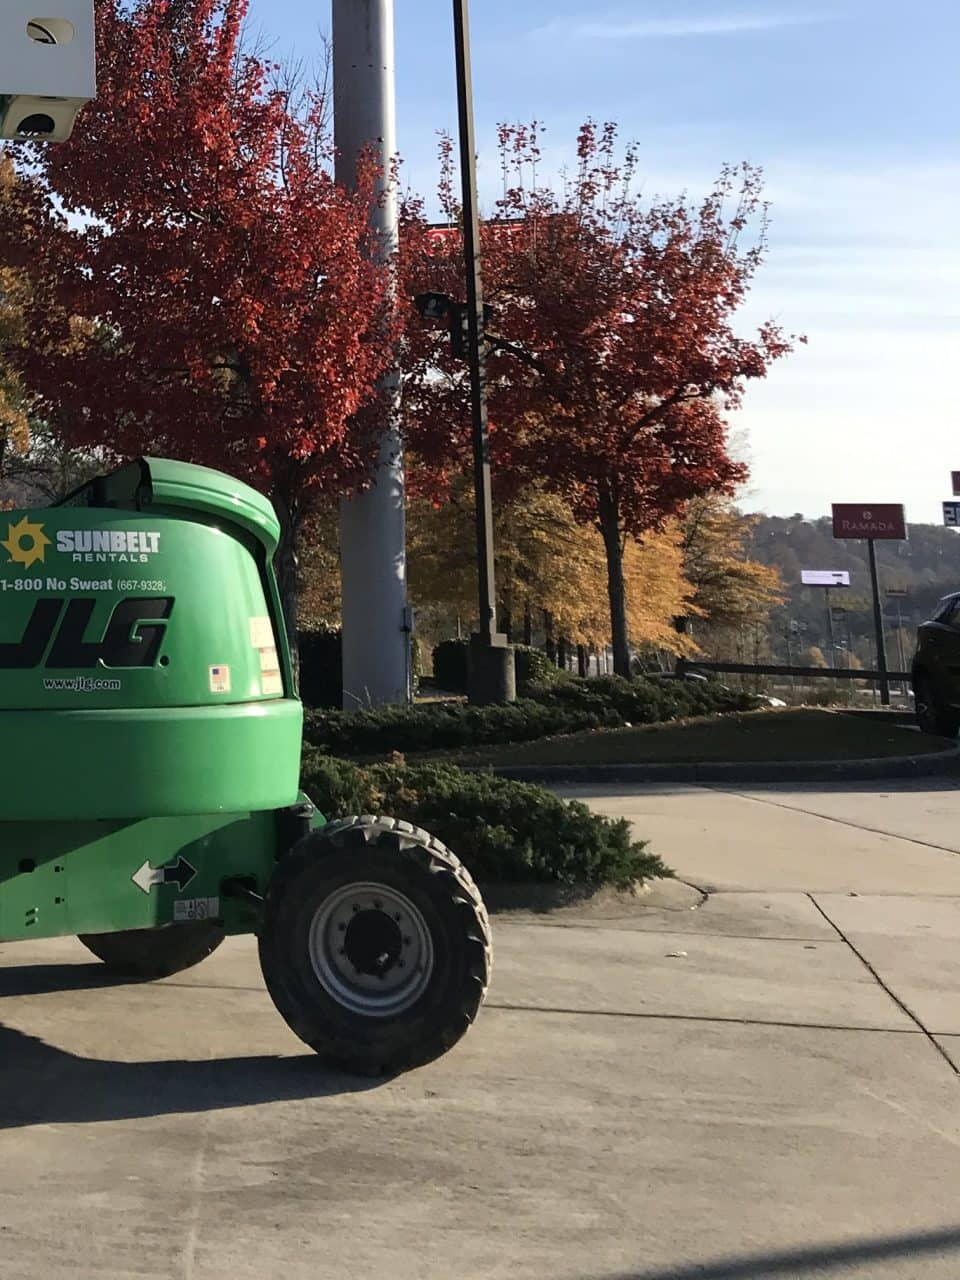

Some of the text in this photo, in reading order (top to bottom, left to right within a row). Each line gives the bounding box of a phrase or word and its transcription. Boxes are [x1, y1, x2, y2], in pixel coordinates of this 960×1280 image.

[842, 520, 895, 531] RAMADA
[56, 531, 160, 553] SUNBELT
[72, 553, 148, 563] RENTALS
[0, 579, 43, 591] 1-800
[46, 577, 66, 590] No
[70, 577, 113, 591] Sweat
[43, 677, 121, 690] www.jlg.com
